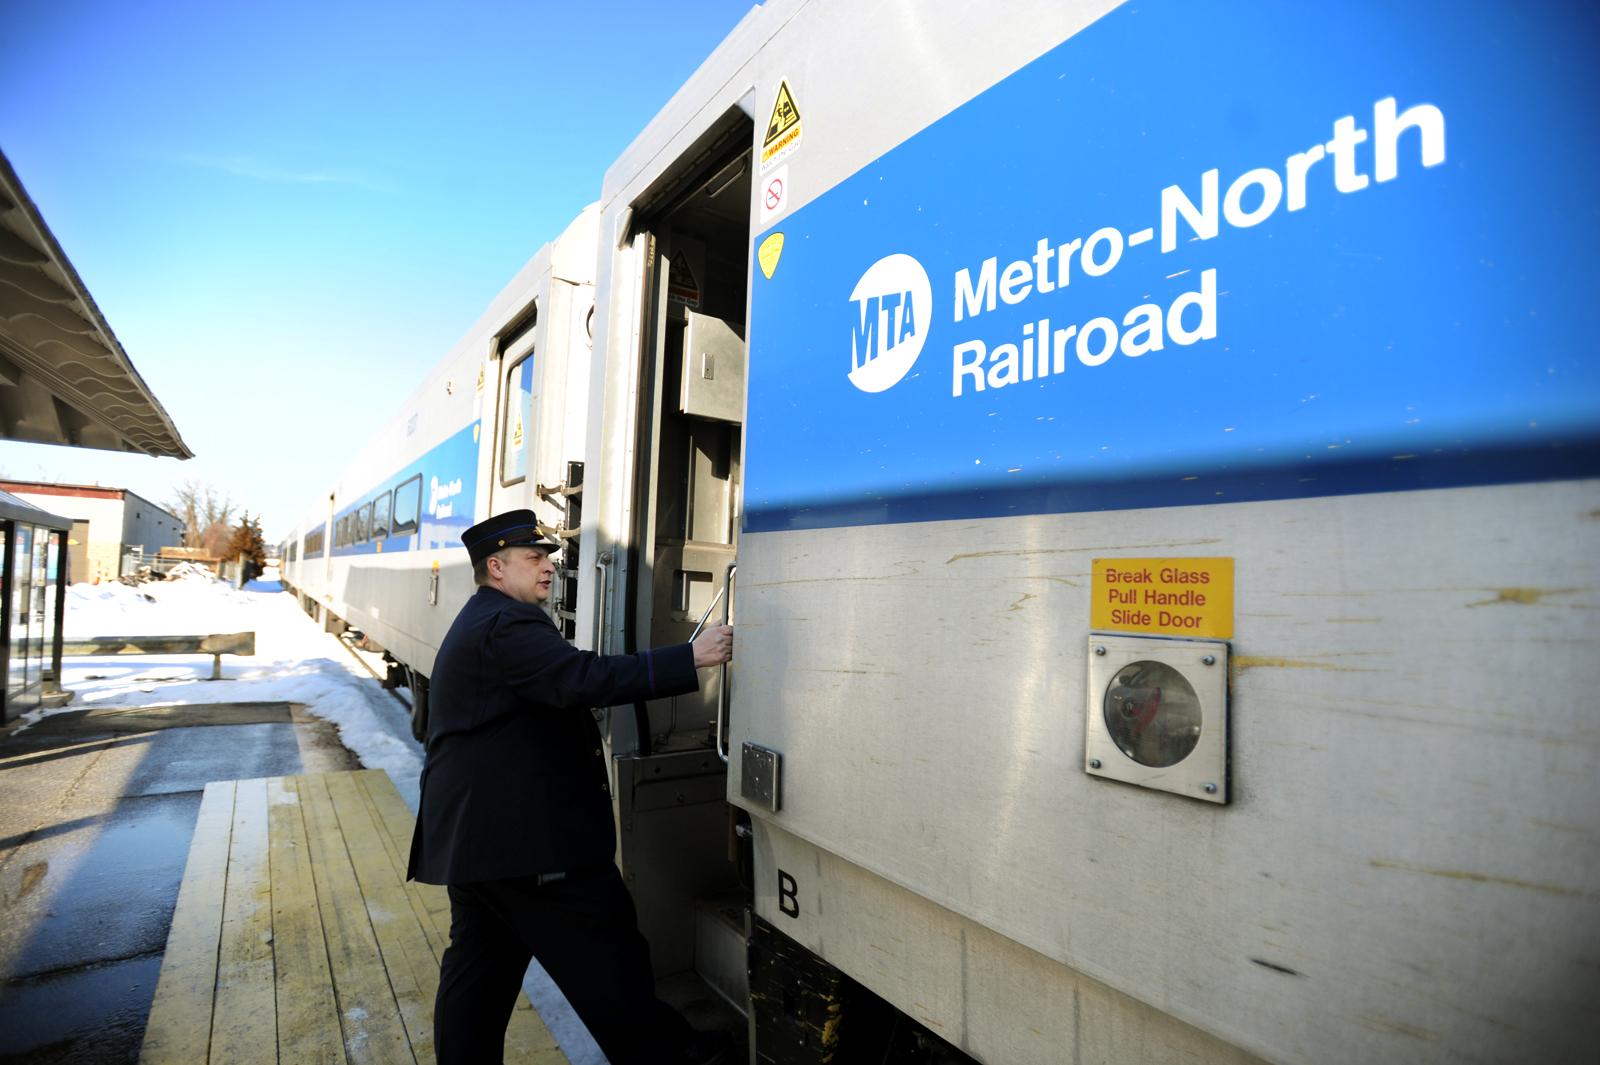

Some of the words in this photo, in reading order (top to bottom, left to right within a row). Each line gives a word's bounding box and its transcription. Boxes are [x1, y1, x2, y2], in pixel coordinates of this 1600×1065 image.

[768, 127, 800, 157] WARNING
[953, 95, 1446, 323] Metro-North
[848, 290, 916, 372] MTA
[951, 267, 1218, 398] Railroad
[1105, 568, 1153, 584] Break
[1159, 567, 1211, 585] Glass
[1108, 588, 1138, 605] Pull
[1144, 589, 1207, 607] Handle
[1111, 609, 1152, 626] Slide
[1158, 610, 1203, 629] Door
[778, 868, 799, 919] B
